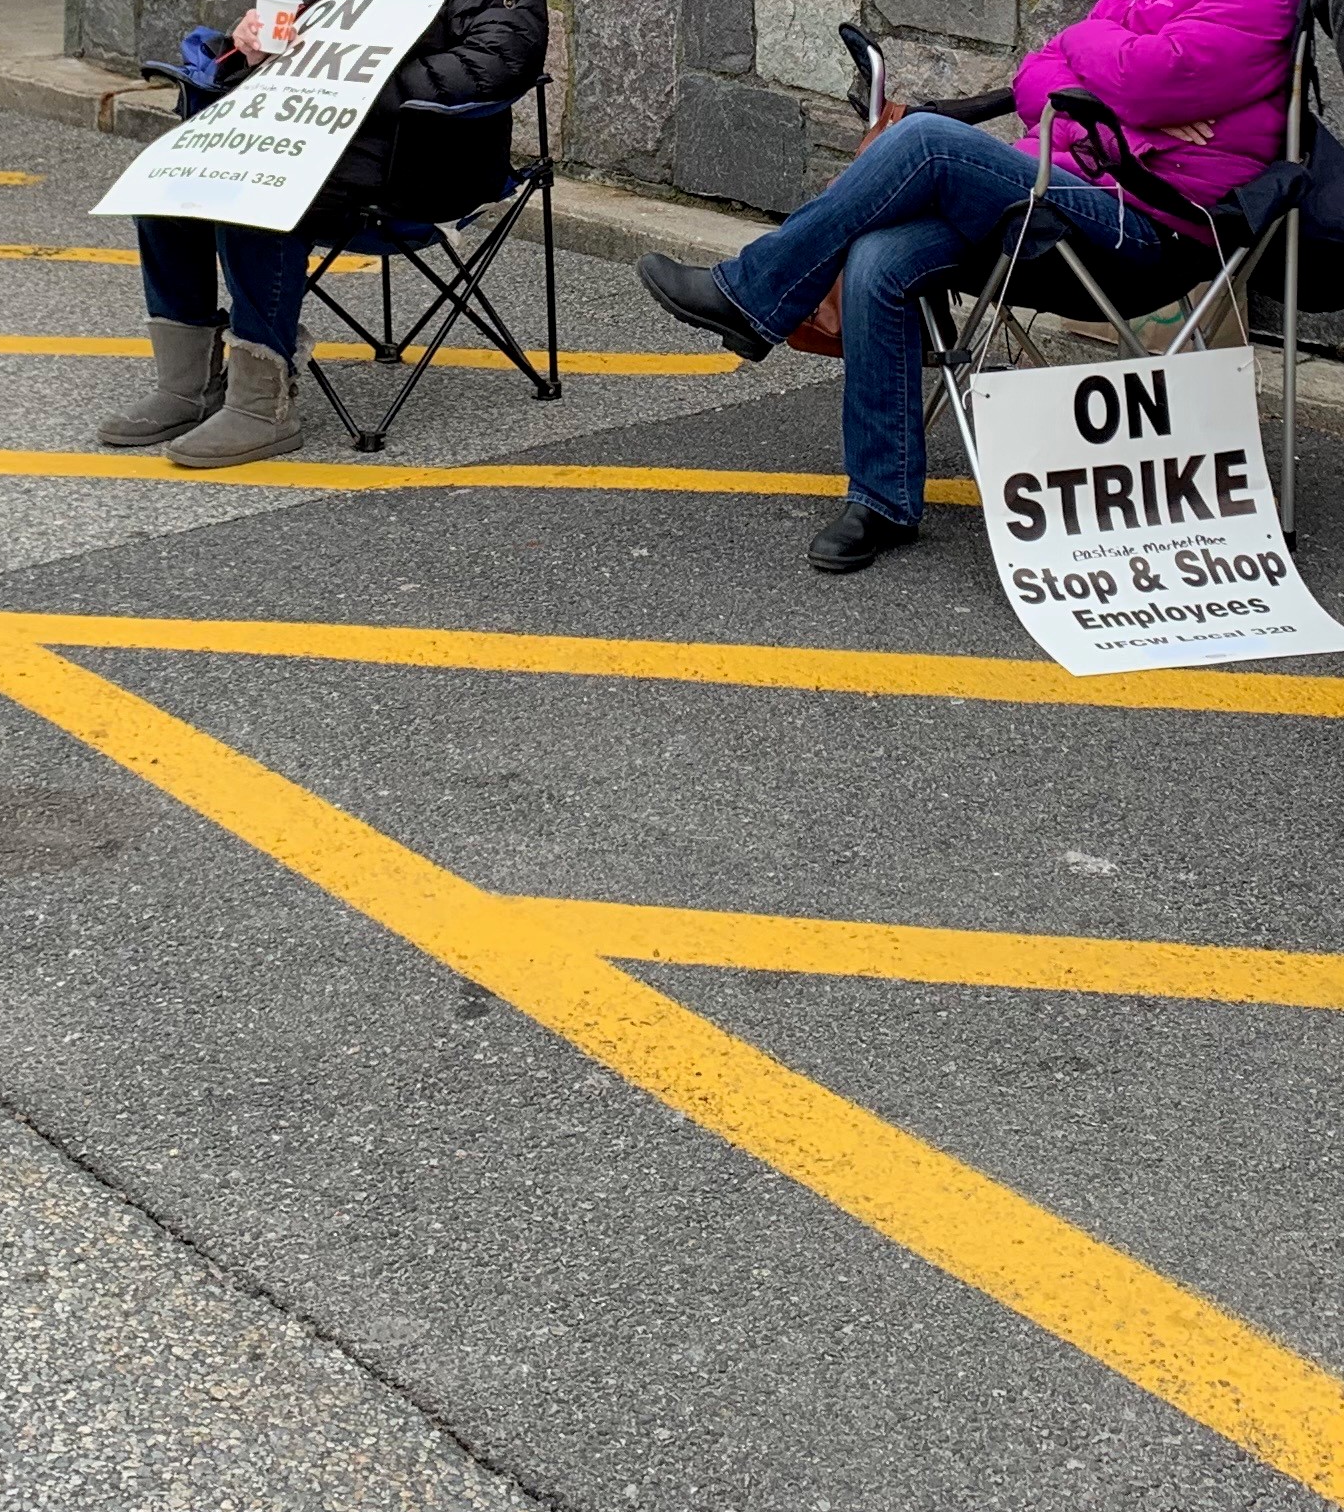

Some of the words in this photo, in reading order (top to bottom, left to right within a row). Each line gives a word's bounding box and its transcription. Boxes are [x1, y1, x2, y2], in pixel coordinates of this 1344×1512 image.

[259, 40, 394, 83] RIKE
[190, 99, 236, 124] op
[240, 93, 267, 119] &
[274, 95, 358, 134] Shop
[171, 127, 306, 156] Employees
[148, 167, 197, 179] UFCW
[198, 167, 249, 182] Local
[251, 173, 287, 188] 328
[1073, 368, 1172, 445] ON
[1003, 448, 1258, 543] STRIKE
[1012, 566, 1119, 606] Stop
[1130, 557, 1170, 595] &
[1176, 547, 1287, 586] Shop
[1072, 595, 1271, 632] Employees
[1095, 635, 1170, 650] UFCW
[1177, 629, 1244, 643] Local
[1253, 625, 1298, 637] 328
